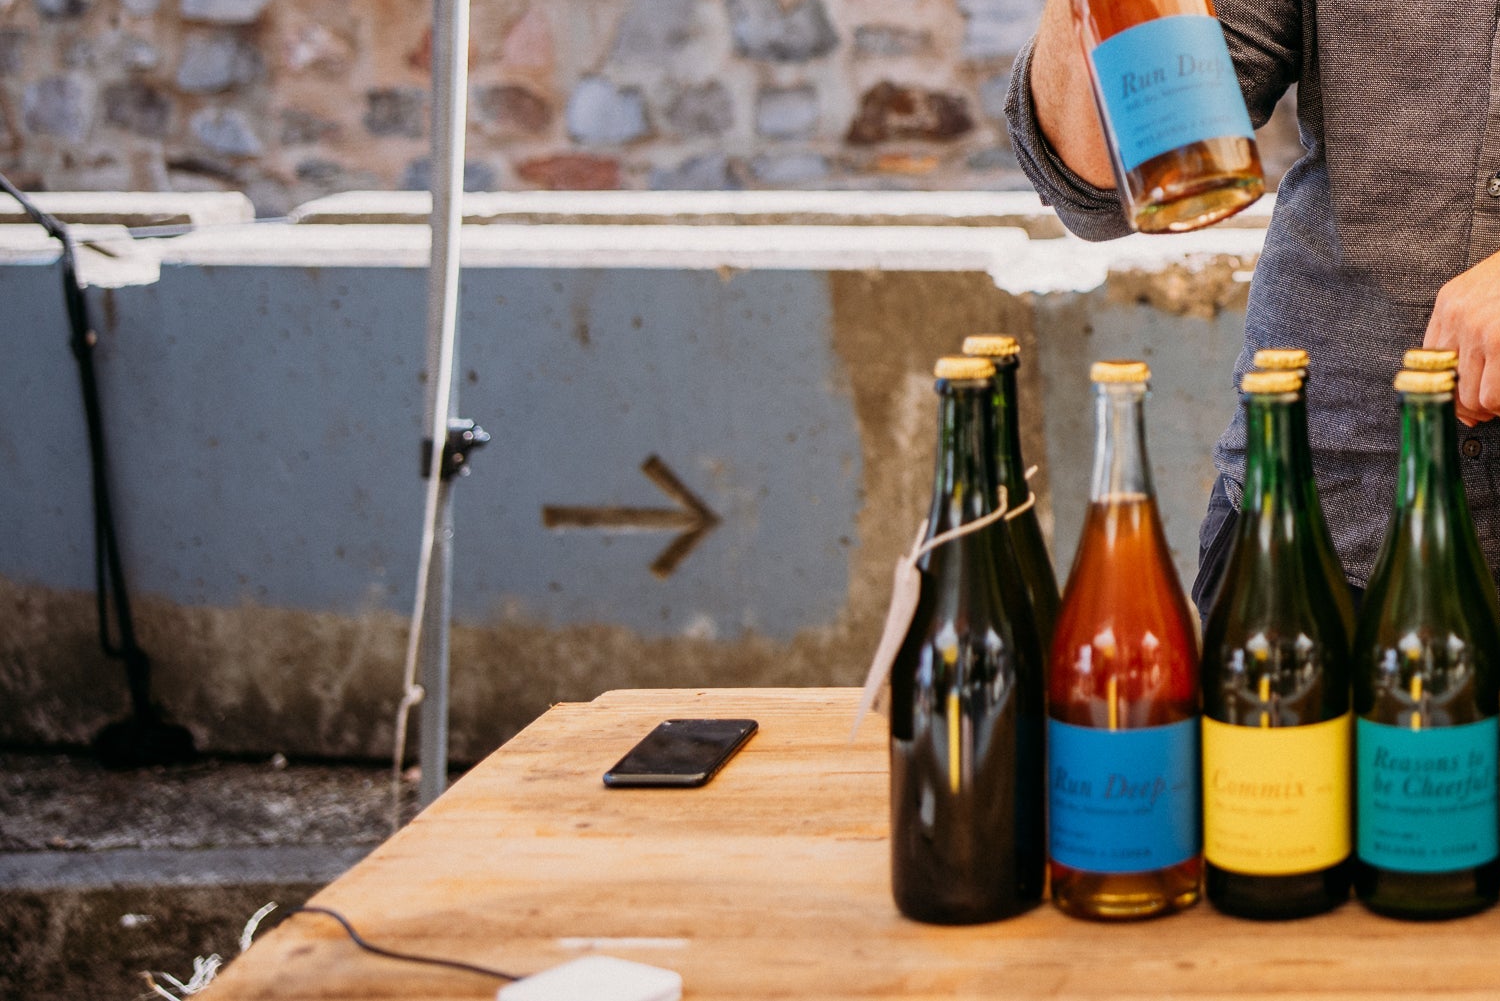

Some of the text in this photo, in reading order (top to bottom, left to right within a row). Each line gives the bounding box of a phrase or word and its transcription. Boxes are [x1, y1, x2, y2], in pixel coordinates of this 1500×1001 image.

[1121, 66, 1167, 99] Run
[1373, 745, 1460, 774] Reasons
[1055, 766, 1168, 807] Run Deep
[1212, 768, 1306, 799] Commix
[1373, 769, 1490, 801] be Cheerful
